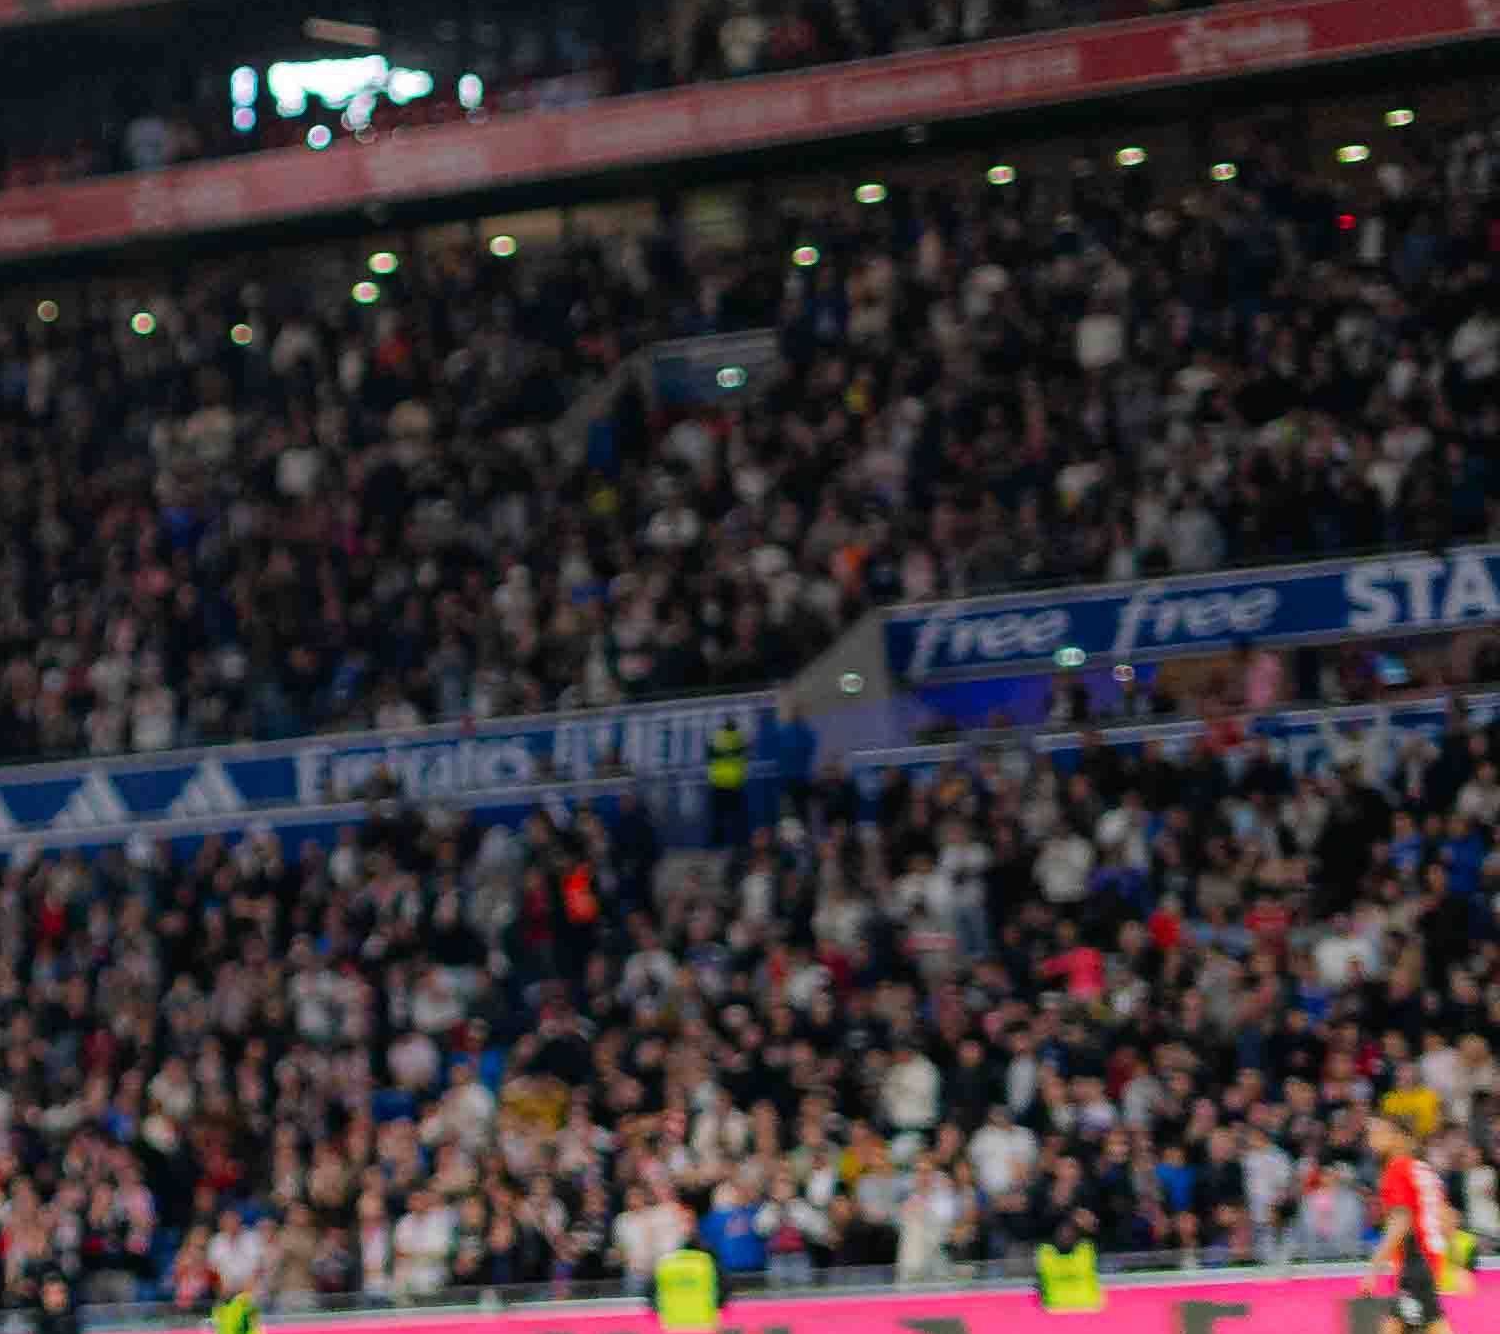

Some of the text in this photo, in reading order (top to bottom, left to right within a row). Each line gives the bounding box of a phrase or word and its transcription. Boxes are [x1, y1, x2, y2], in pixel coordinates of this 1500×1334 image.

[908, 553, 1500, 681] free free STA
